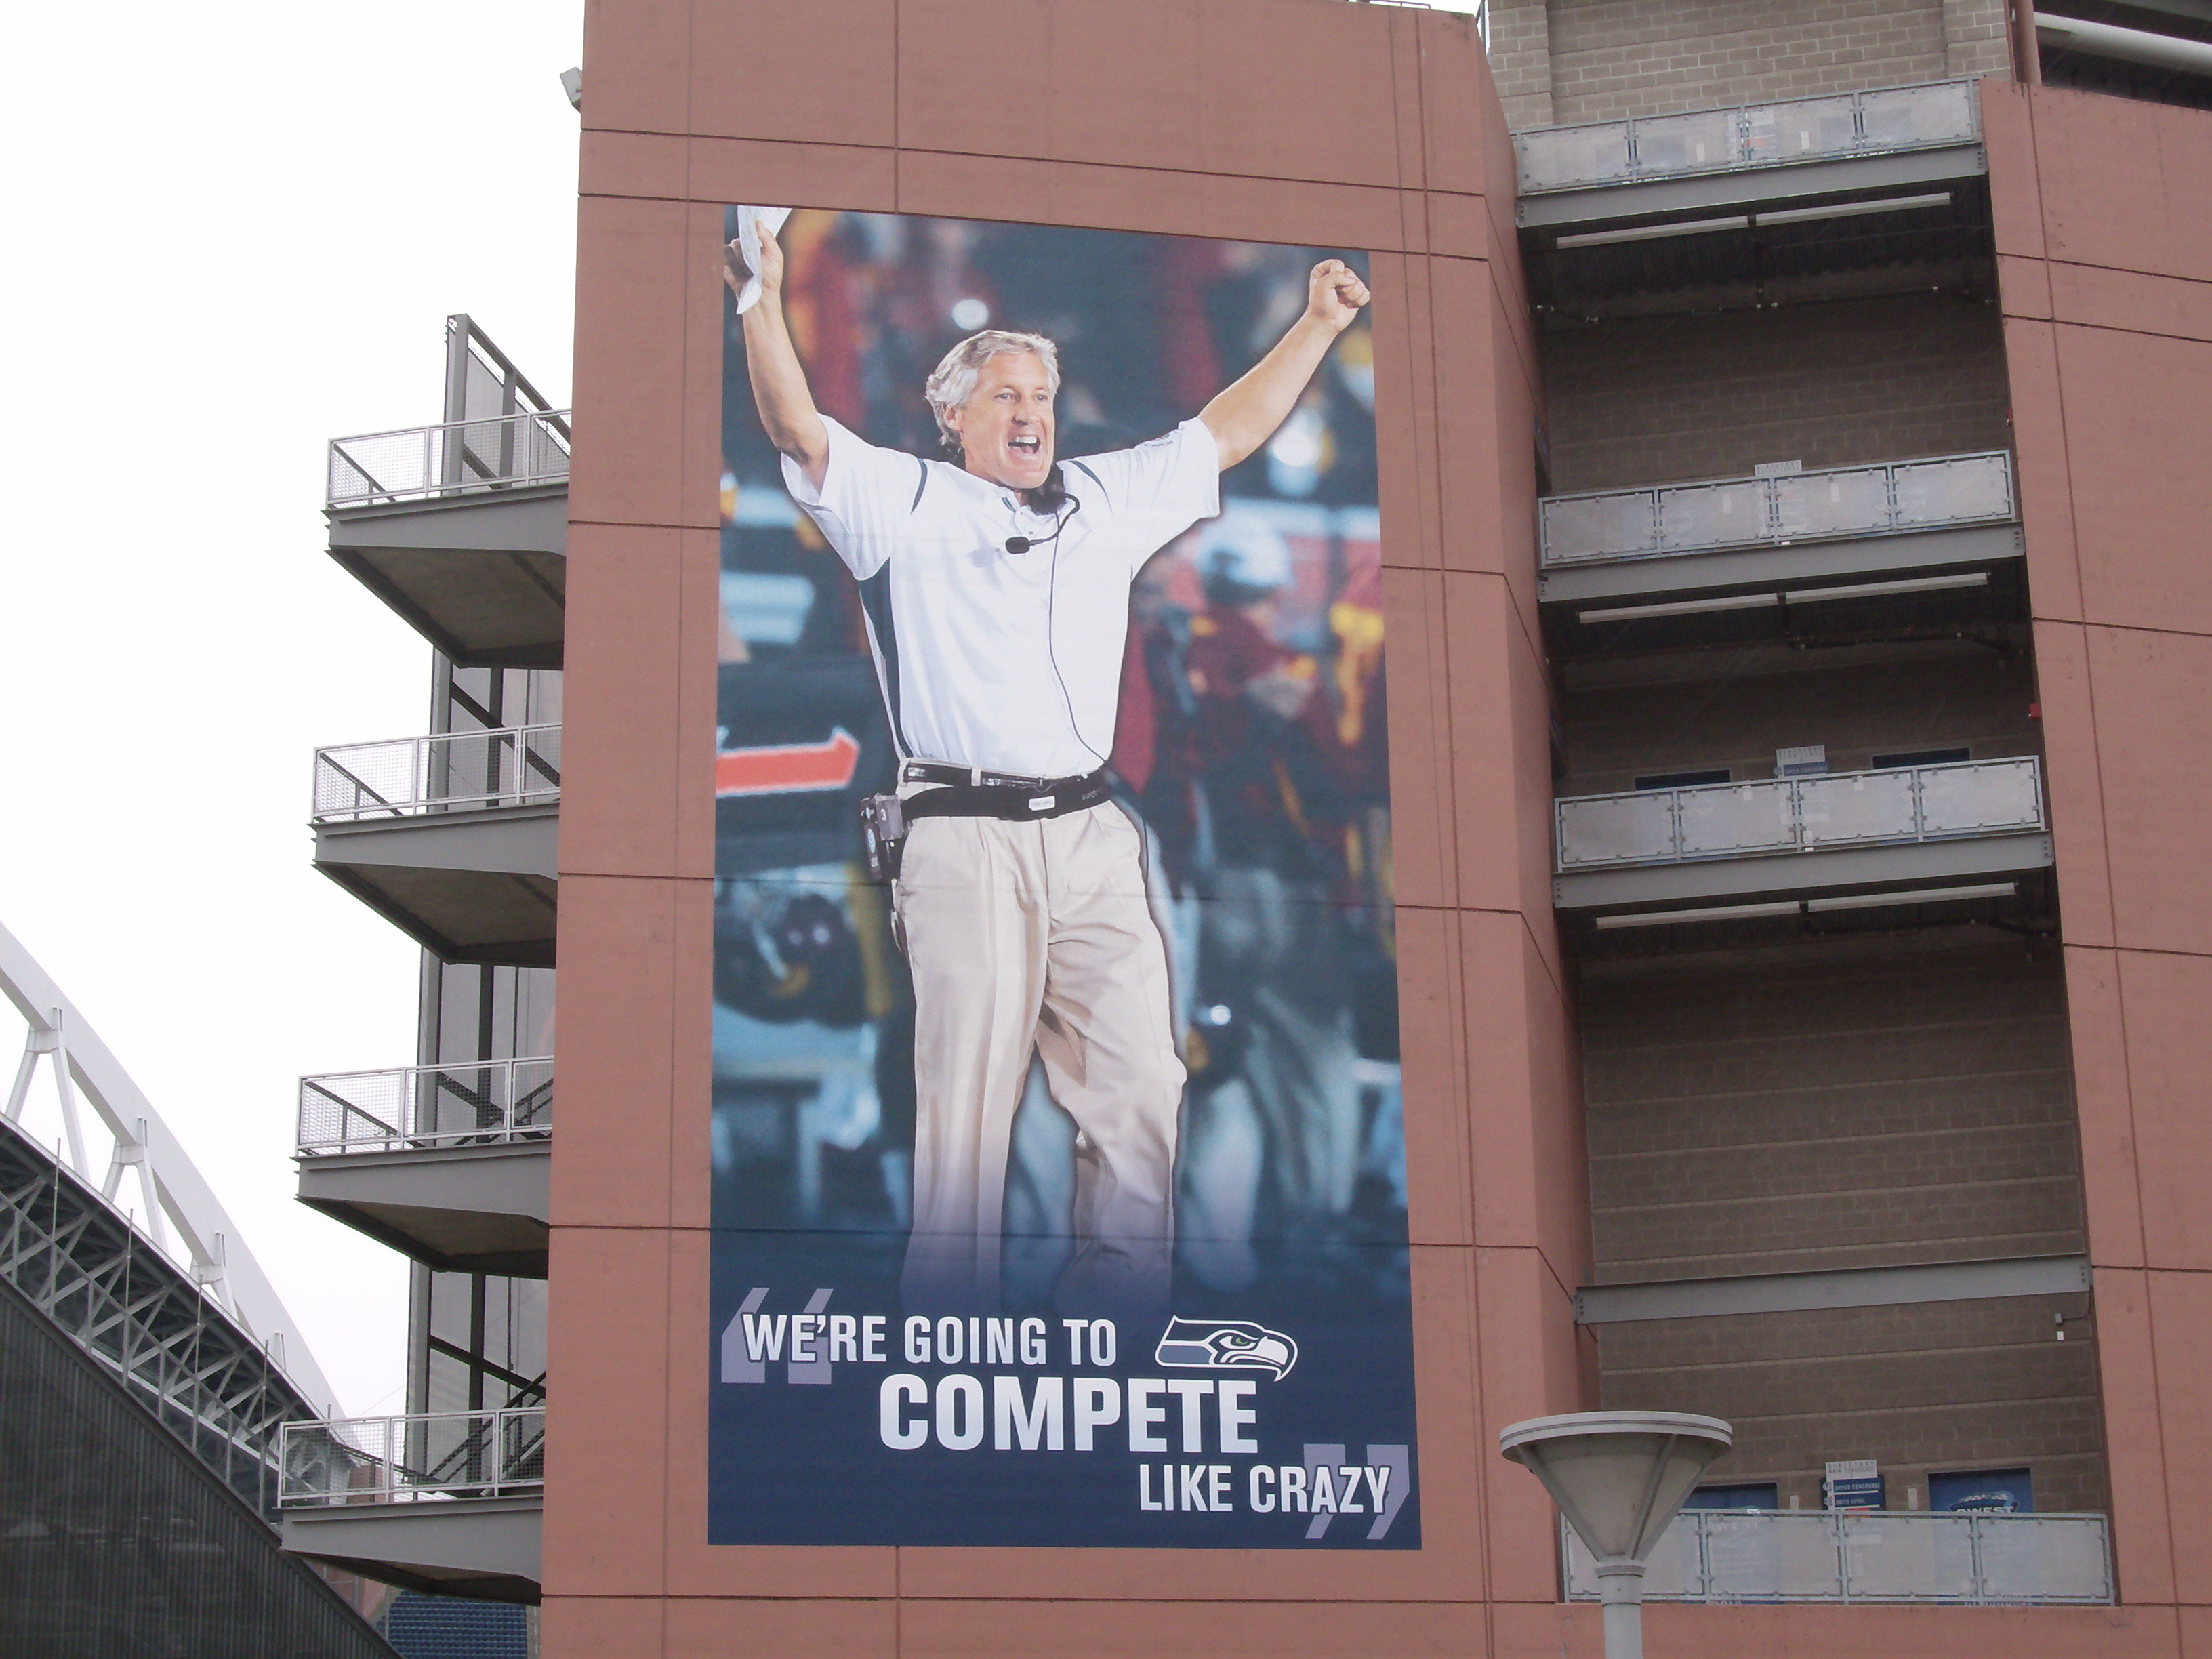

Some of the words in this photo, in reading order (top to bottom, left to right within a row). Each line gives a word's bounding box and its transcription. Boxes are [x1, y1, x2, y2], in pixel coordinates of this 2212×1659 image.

[742, 1313, 887, 1363] WE'RE
[904, 1315, 1047, 1366] GOING
[1062, 1317, 1117, 1367] TO
[879, 1373, 1258, 1454] COMPETE
[1139, 1463, 1233, 1512] LIKE
[1249, 1464, 1391, 1513] CRAZY
